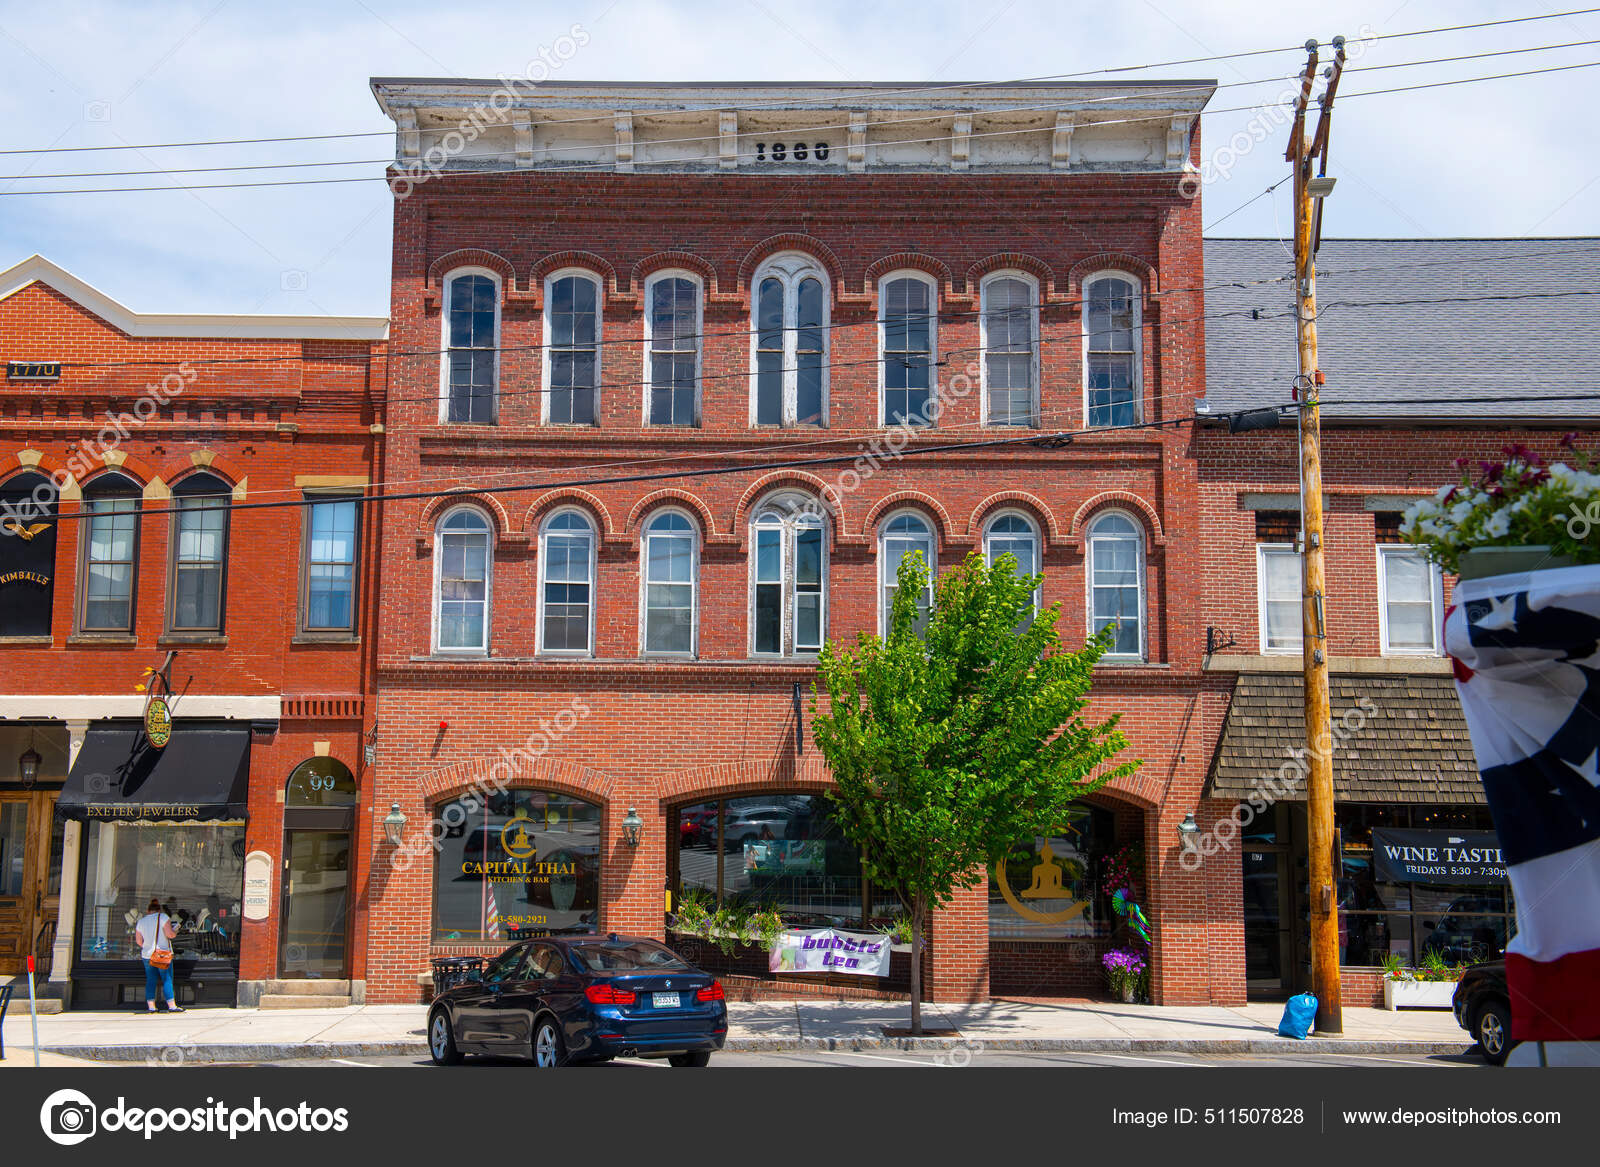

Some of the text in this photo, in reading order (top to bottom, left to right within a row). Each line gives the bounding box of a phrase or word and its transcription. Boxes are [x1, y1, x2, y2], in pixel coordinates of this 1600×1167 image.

[310, 775, 336, 791] 99
[86, 805, 200, 819] EXETER JEWELERS
[1384, 845, 1507, 863] WINE TASTI
[461, 861, 576, 875] CAPITAL THAI
[1406, 865, 1447, 875] FRIDAYS
[1450, 866, 1471, 875] 5:30
[1480, 867, 1509, 878] 7:30p
[488, 876, 550, 884] KITCHEN & BAR
[802, 935, 881, 954] bubble
[822, 951, 860, 969] tea
